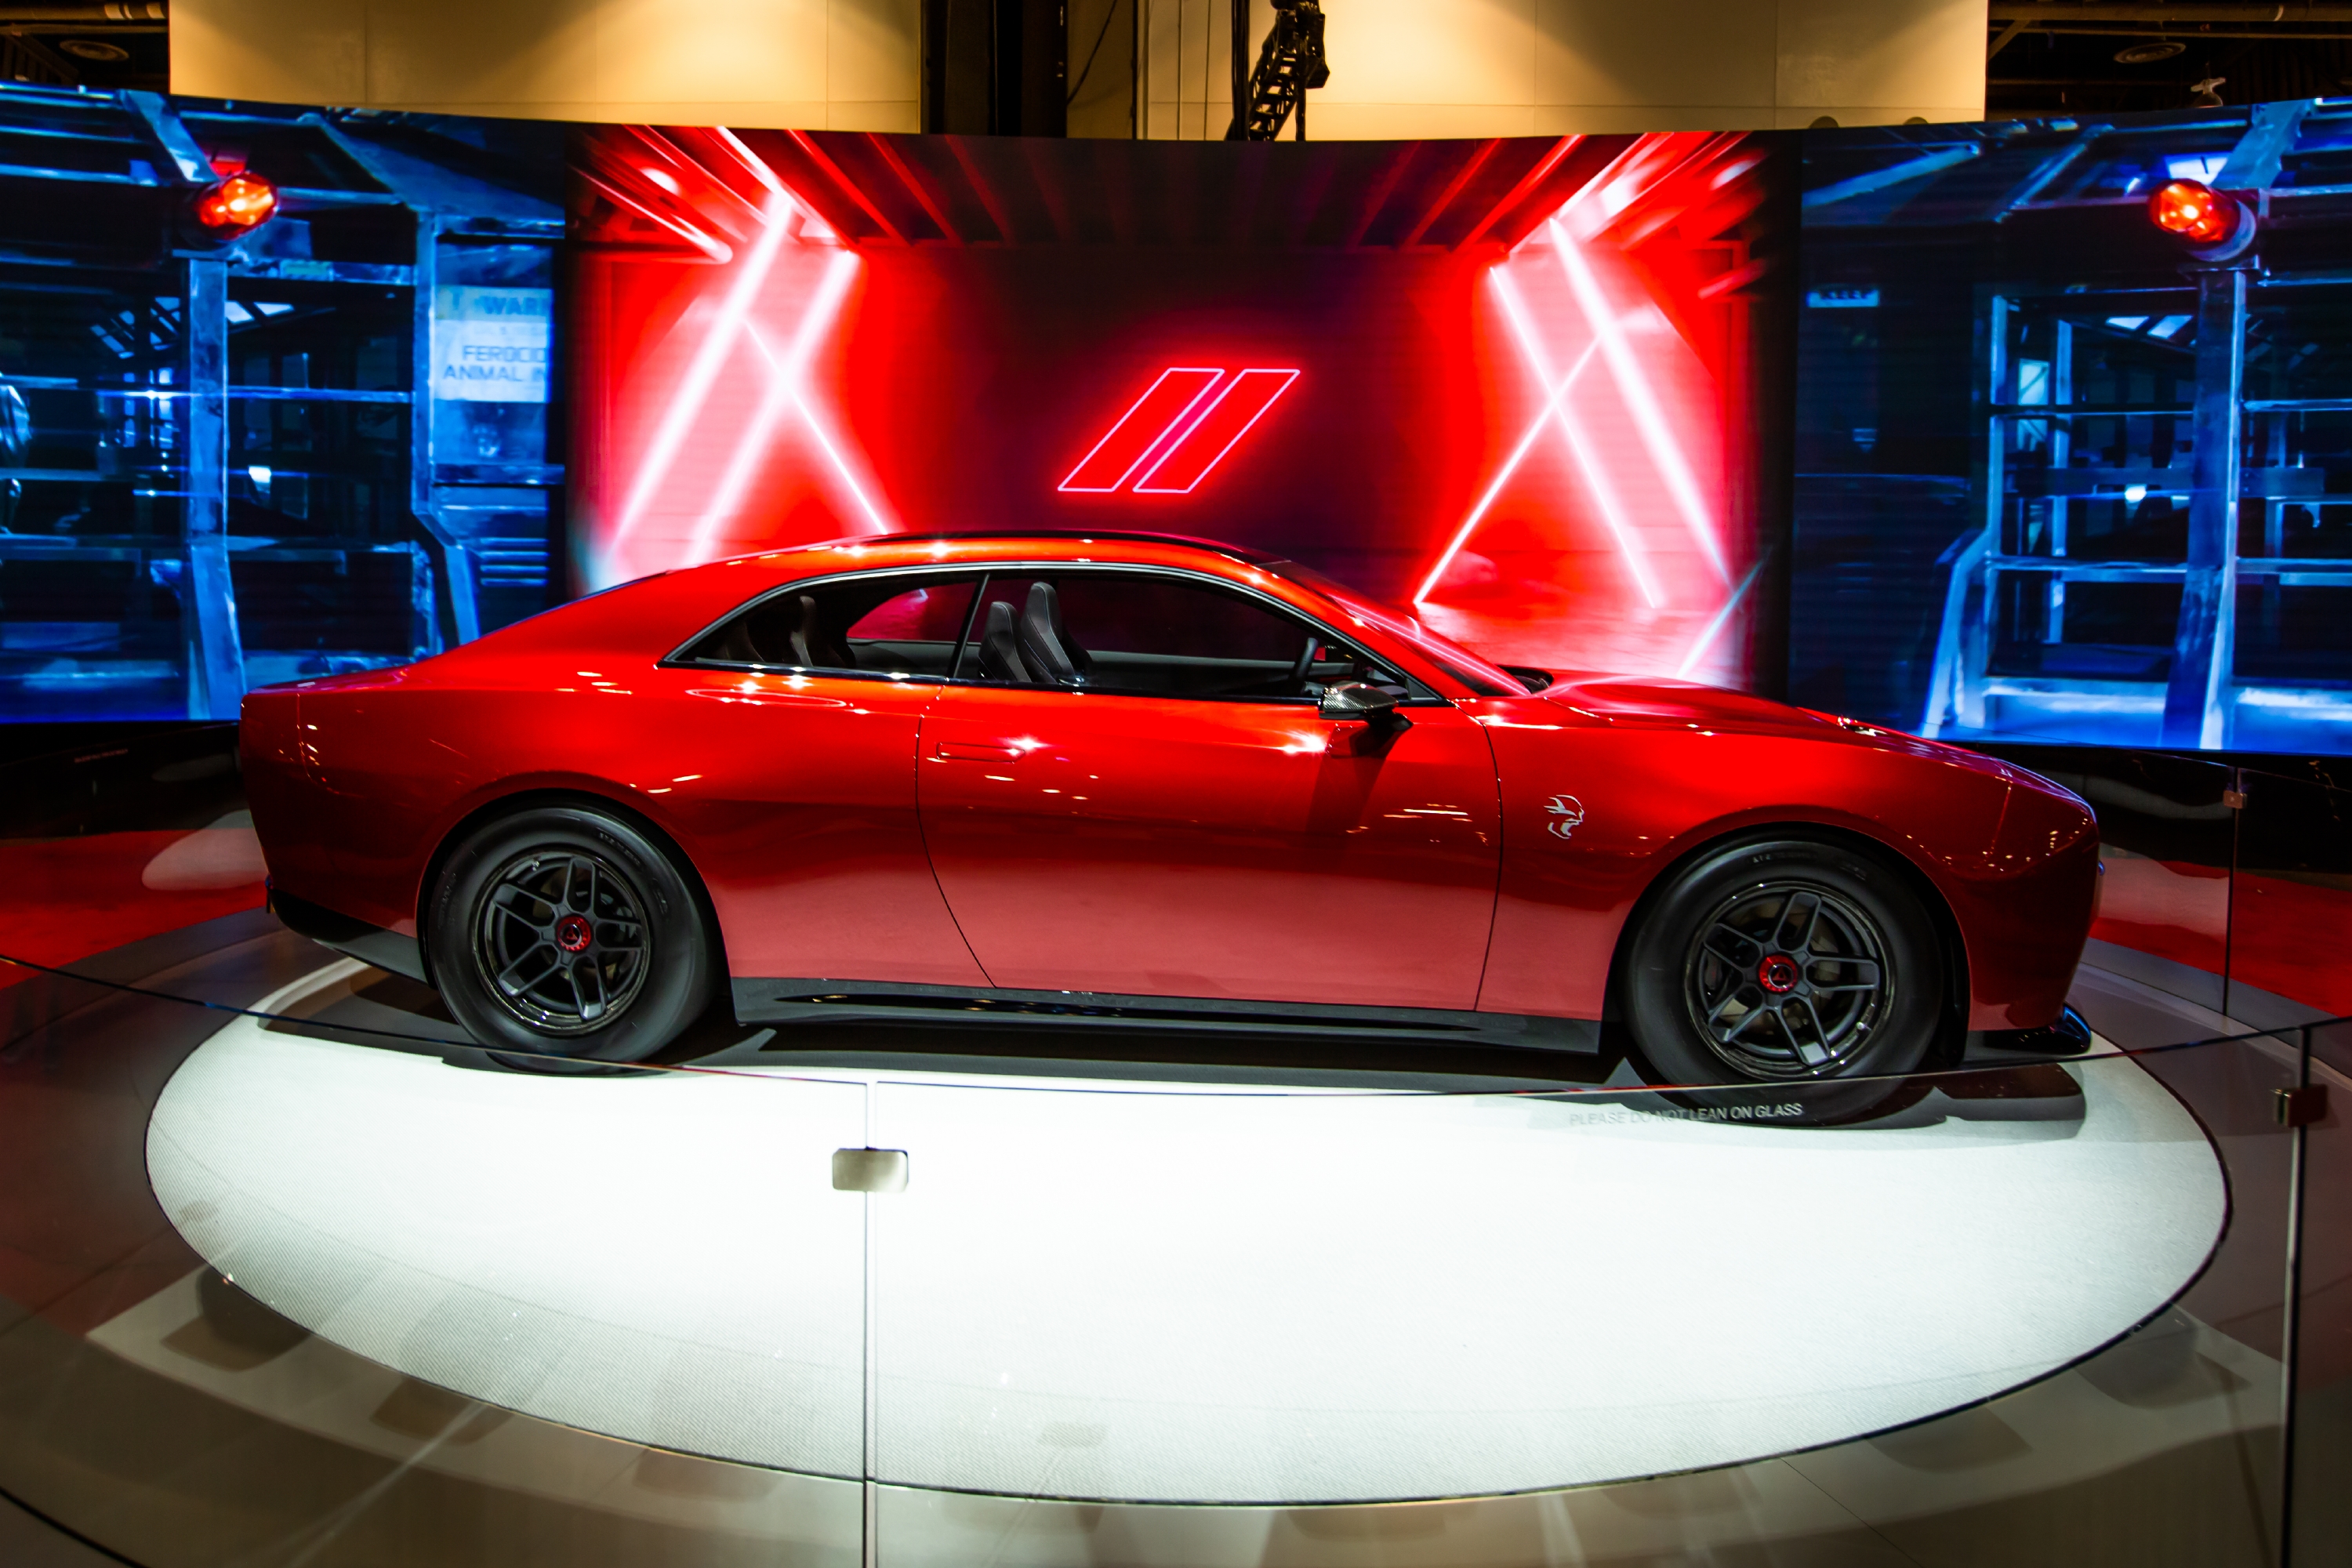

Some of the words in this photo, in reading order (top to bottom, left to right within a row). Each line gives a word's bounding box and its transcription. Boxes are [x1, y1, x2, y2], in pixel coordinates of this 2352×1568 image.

[442, 365, 523, 382] ANIMAL
[1570, 1112, 1626, 1126] PLEASE
[1630, 1110, 1652, 1123] DO
[1654, 1109, 1686, 1123] NOT
[1688, 1106, 1727, 1121] LEAN
[1730, 1105, 1752, 1120] ON
[1755, 1102, 1803, 1118] GLASS
